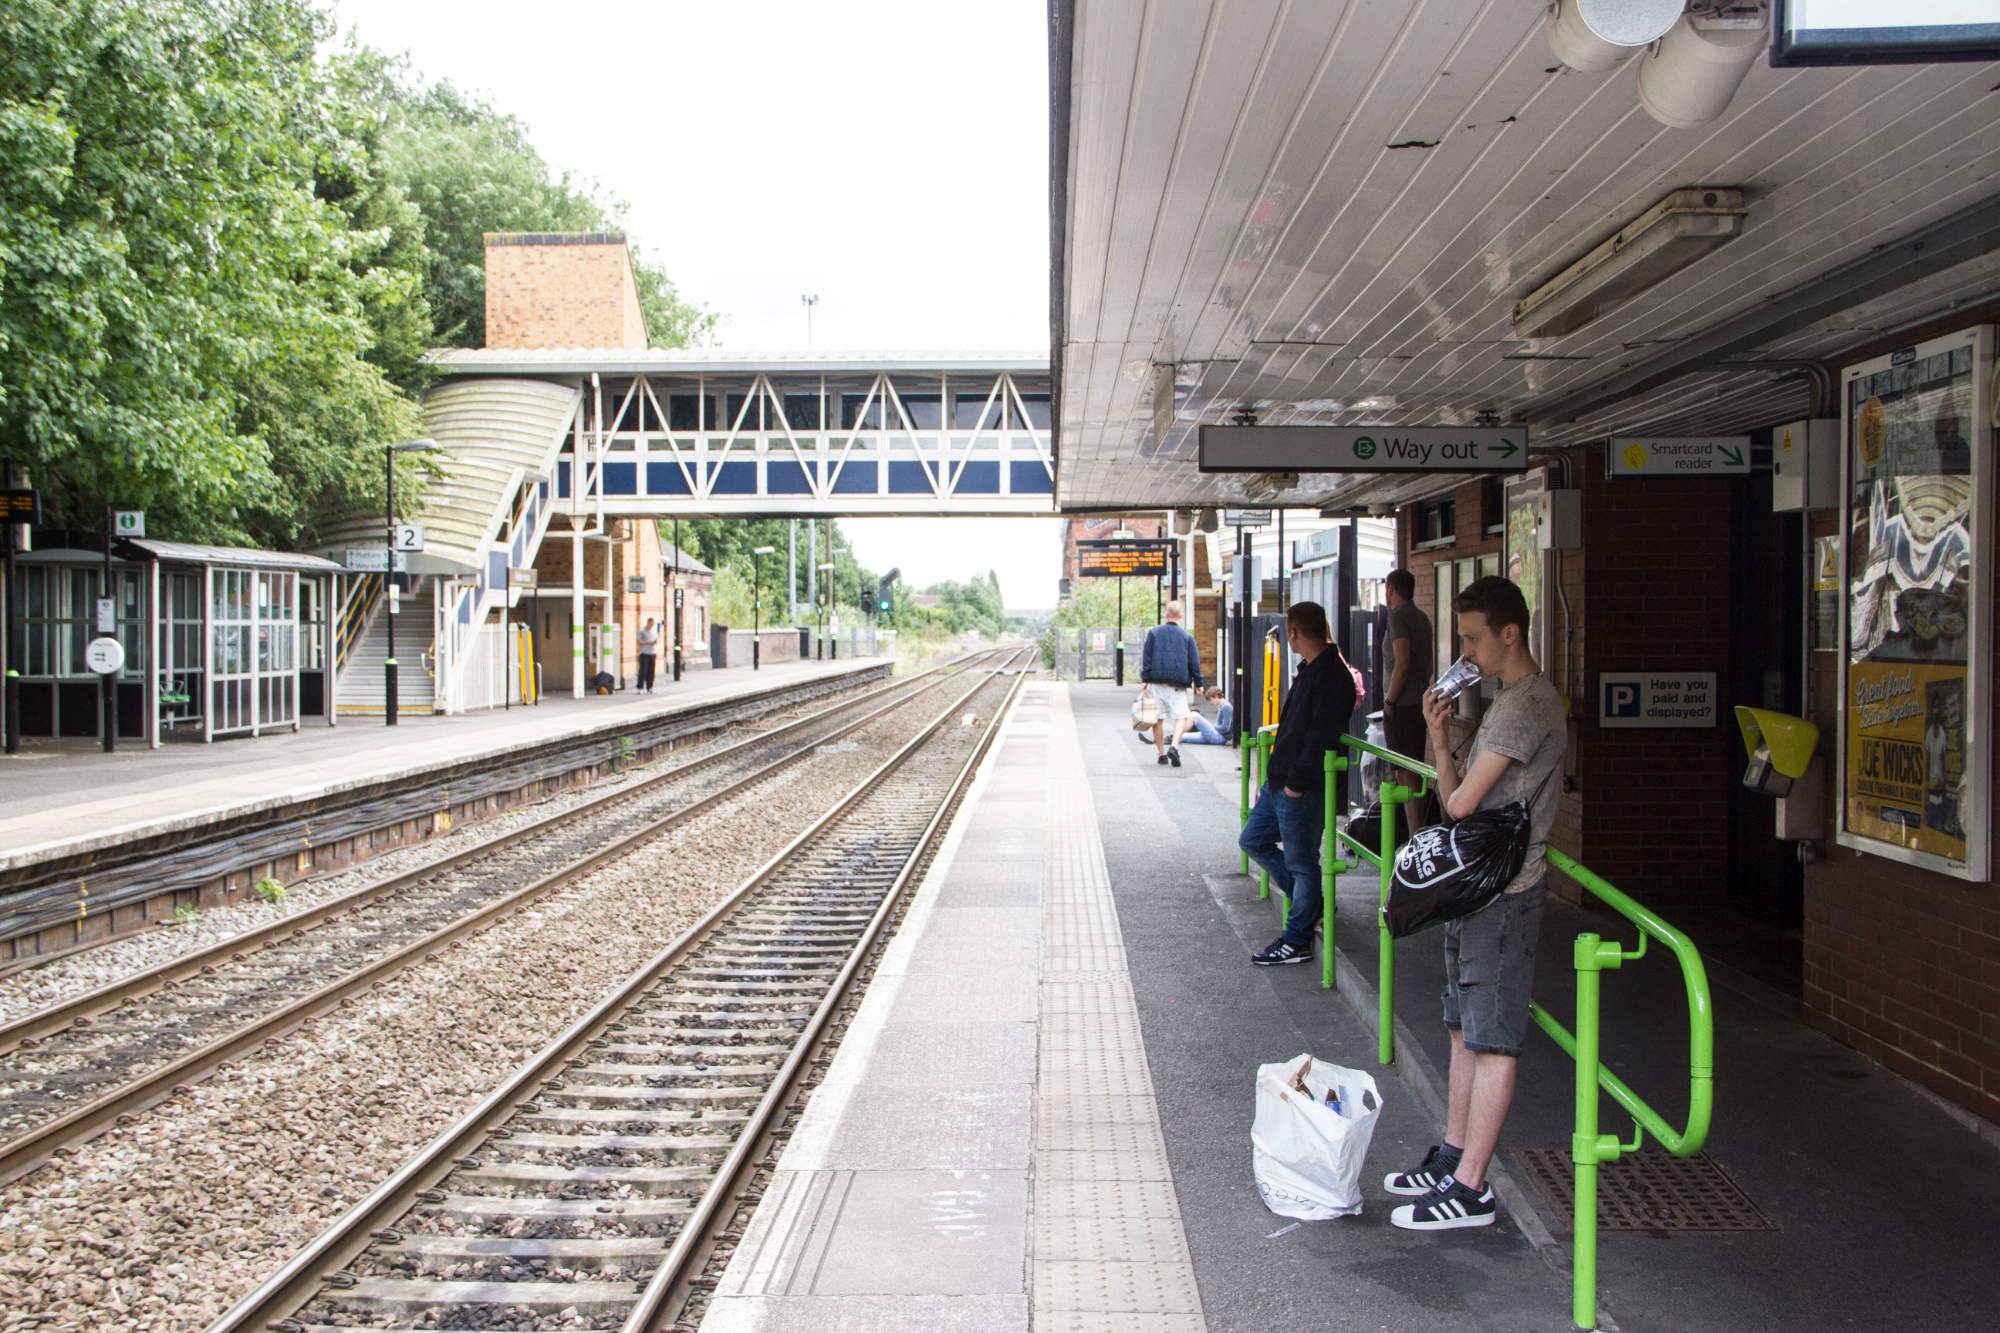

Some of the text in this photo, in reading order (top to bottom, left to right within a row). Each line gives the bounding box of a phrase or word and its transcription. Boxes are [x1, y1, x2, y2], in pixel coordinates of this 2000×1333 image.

[1383, 438, 1479, 465] Way out
[1651, 442, 1712, 456] Smartcard
[1674, 456, 1712, 469] reader
[405, 529, 415, 546] 2
[1650, 679, 1708, 691] Have you
[1612, 685, 1634, 716] P
[1652, 693, 1706, 704] paid and
[1646, 706, 1712, 719] displayed?
[1857, 739, 1924, 786] JOE WICKS
